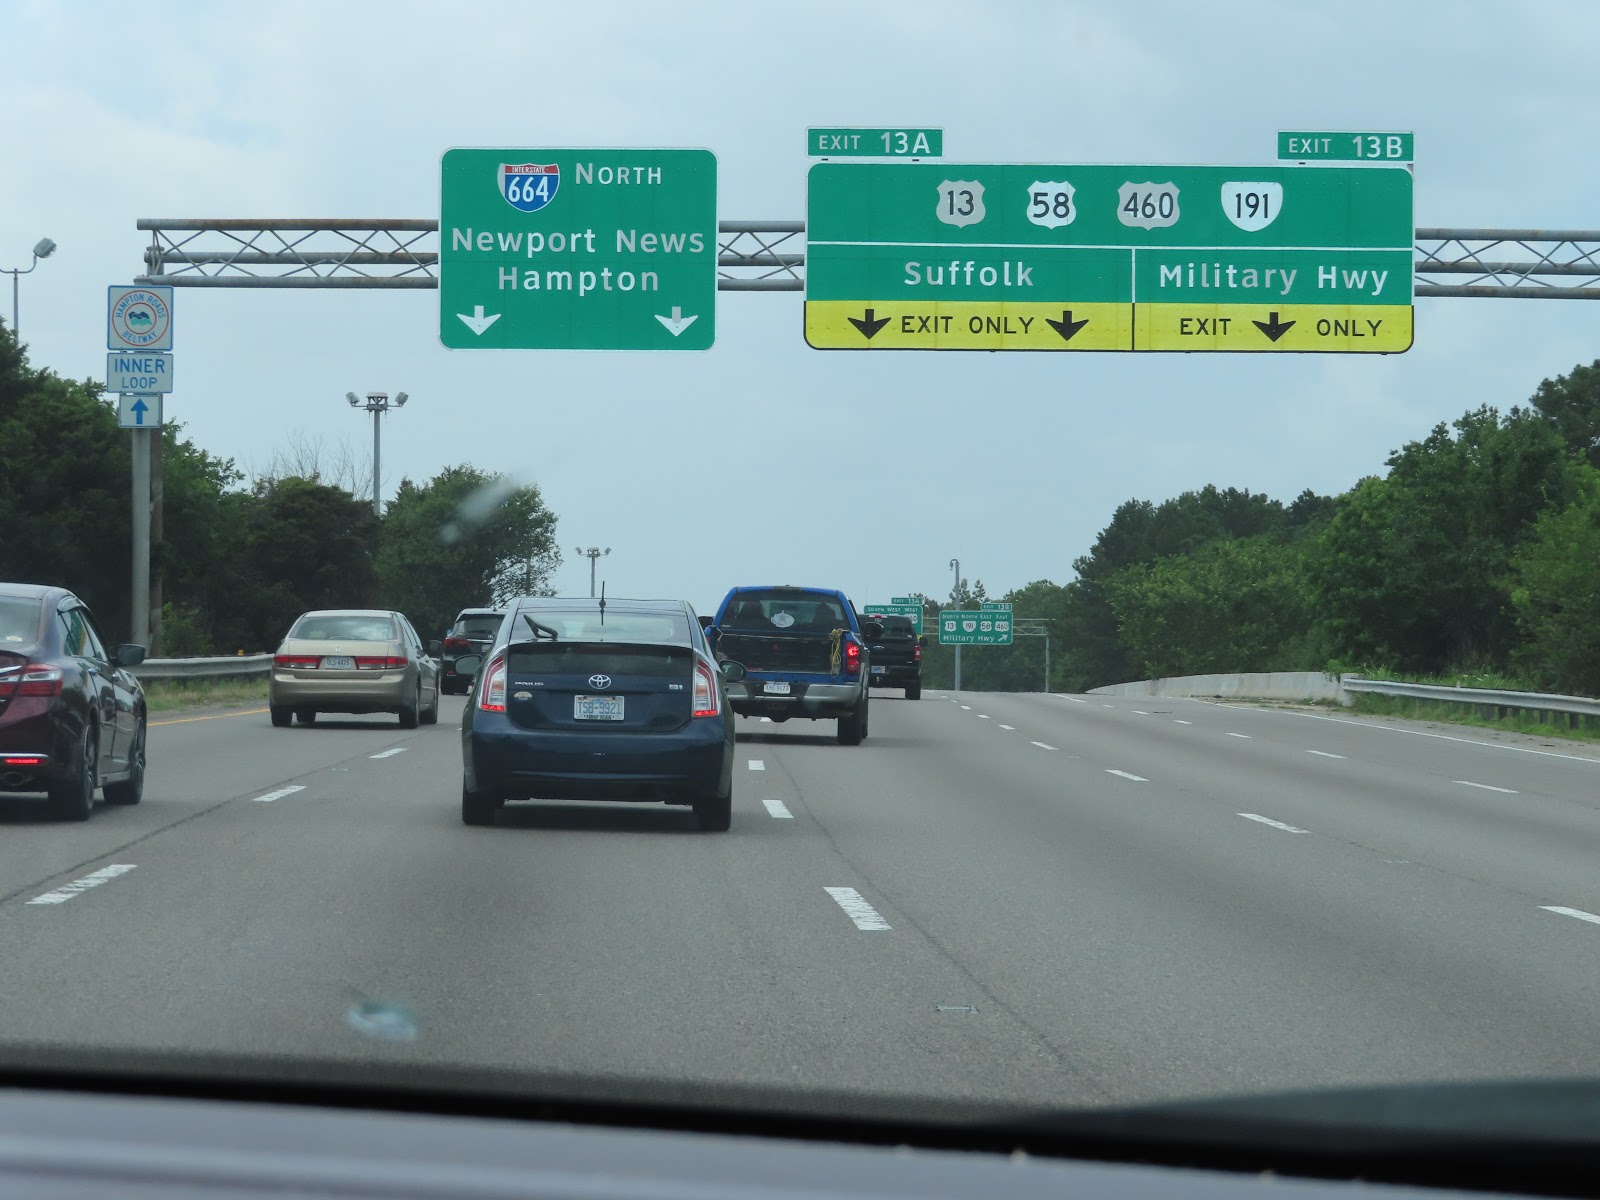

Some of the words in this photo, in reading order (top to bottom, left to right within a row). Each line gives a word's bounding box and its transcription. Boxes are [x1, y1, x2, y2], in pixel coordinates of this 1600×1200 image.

[819, 135, 861, 150] EXIT
[880, 132, 931, 154] 13A
[1288, 138, 1332, 153] EXIT
[1352, 136, 1403, 158] 13B
[511, 166, 546, 174] INTERSTATE
[575, 163, 662, 185] NORTH
[508, 176, 549, 203] 664
[947, 190, 975, 216] 13
[1032, 192, 1070, 219] 58
[1123, 192, 1174, 219] 460
[1235, 193, 1269, 219] 191
[452, 228, 596, 258] Newport
[616, 230, 705, 253] News
[498, 266, 659, 297] Hampton
[904, 261, 1034, 287] Suffolk
[1160, 263, 1298, 296] Military
[1317, 265, 1388, 296] Hwy
[116, 294, 145, 318] HAMPTON
[147, 295, 166, 319] ROADS
[901, 316, 954, 334] EXIT
[969, 317, 1035, 334] ONLY
[1180, 318, 1232, 336] EXIT
[1316, 319, 1383, 337] ONLY
[122, 330, 158, 344] BELTWAY
[114, 358, 166, 374] INNER
[121, 376, 158, 389] LOOP
[947, 622, 955, 630] 13
[981, 622, 991, 630] 58
[996, 622, 1008, 631] 460
[943, 634, 975, 643] Military
[978, 635, 995, 643] Hwy
[577, 701, 622, 715] TSB-9921
